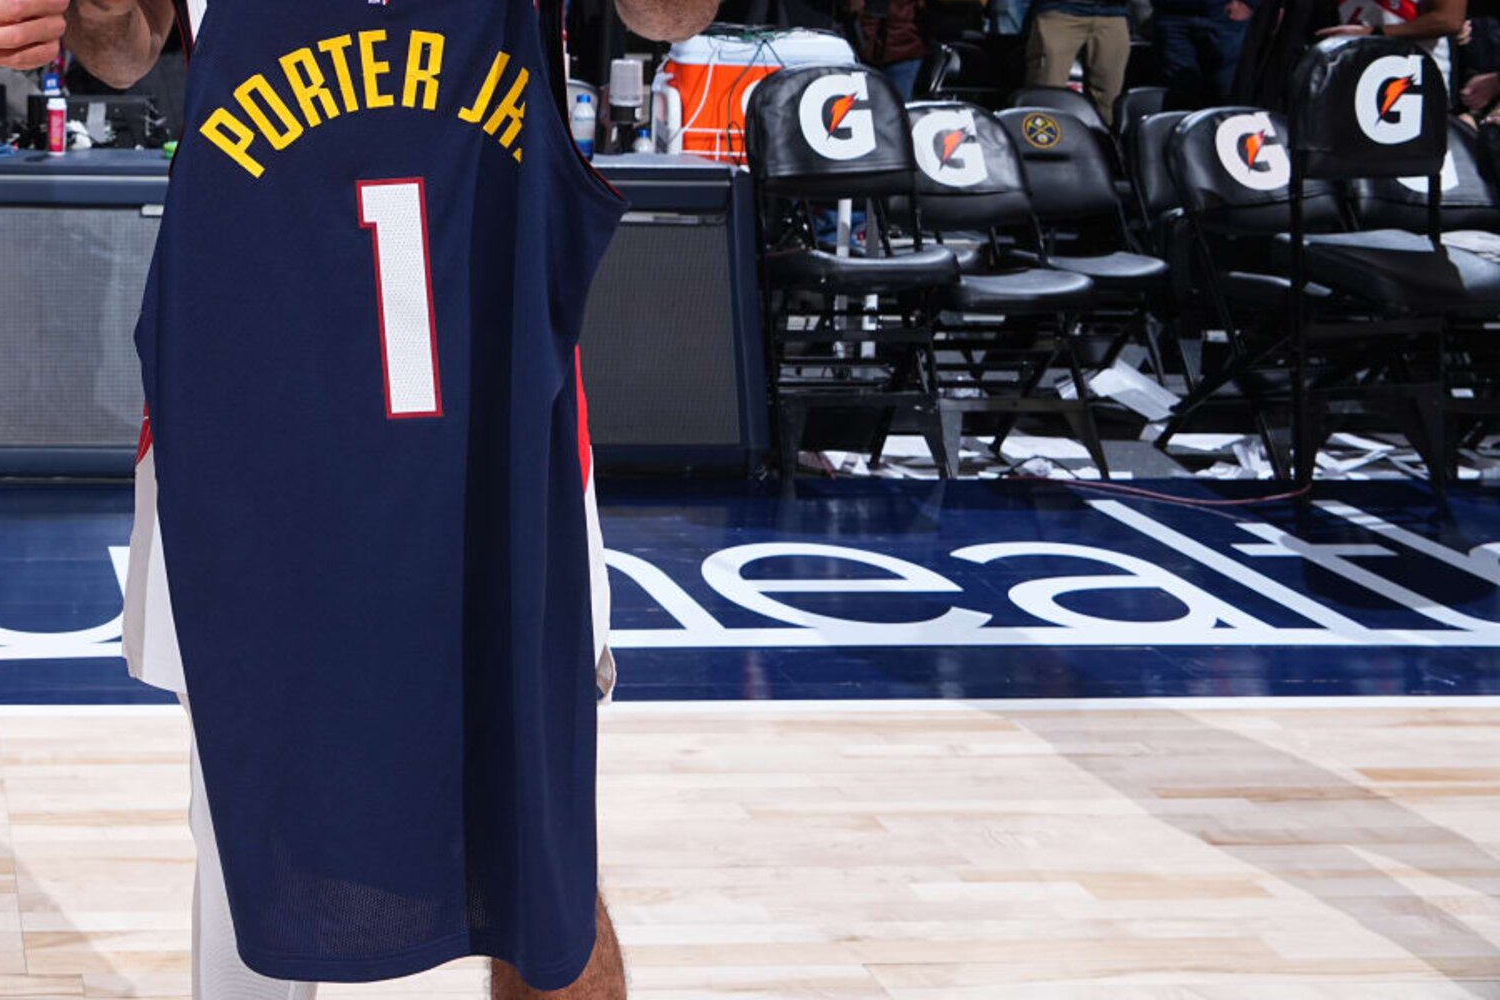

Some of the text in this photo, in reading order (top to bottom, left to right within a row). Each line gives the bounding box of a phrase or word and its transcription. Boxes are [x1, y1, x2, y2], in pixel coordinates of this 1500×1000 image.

[200, 29, 445, 178] PORTER
[799, 71, 876, 160] G
[911, 109, 987, 177] G
[1355, 55, 1423, 144] G
[1215, 111, 1291, 190] G
[356, 177, 443, 419] 1
